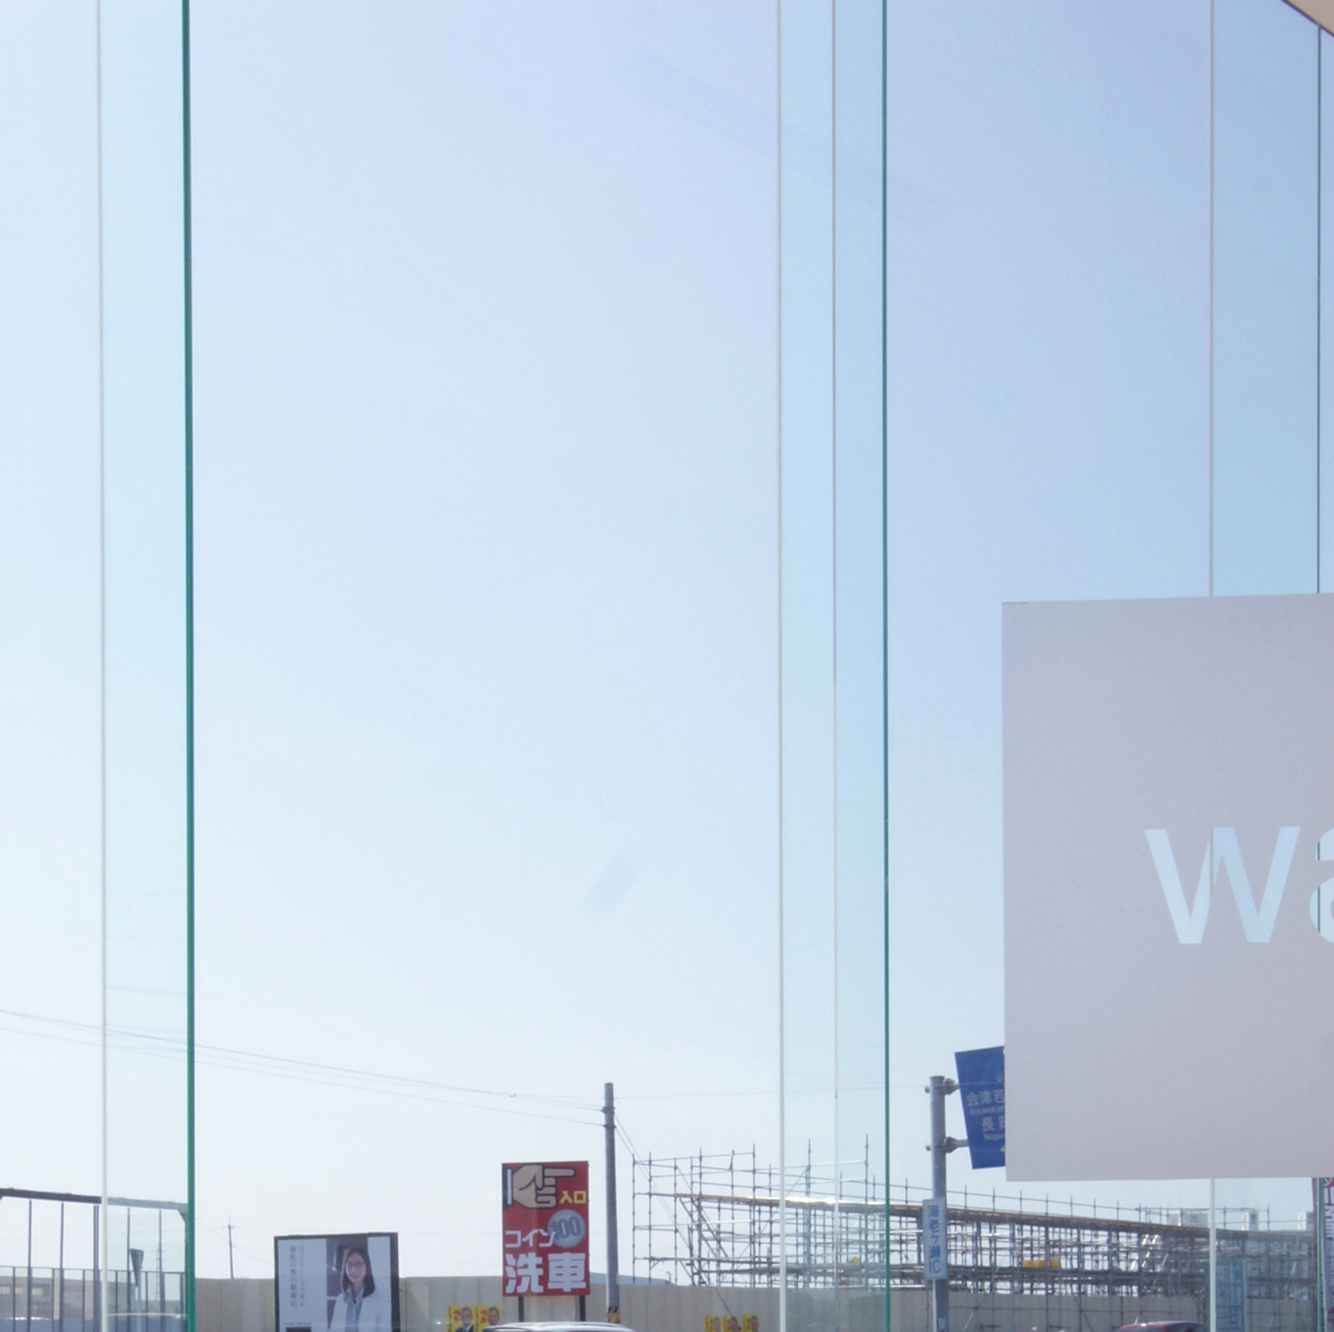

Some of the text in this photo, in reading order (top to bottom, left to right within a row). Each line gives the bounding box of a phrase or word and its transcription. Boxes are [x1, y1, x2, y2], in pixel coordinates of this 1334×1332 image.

[966, 1089, 1004, 1107] 会津若
[559, 1190, 587, 1205] 入口
[505, 1229, 556, 1248] コイン
[505, 1251, 587, 1293] 洗車
